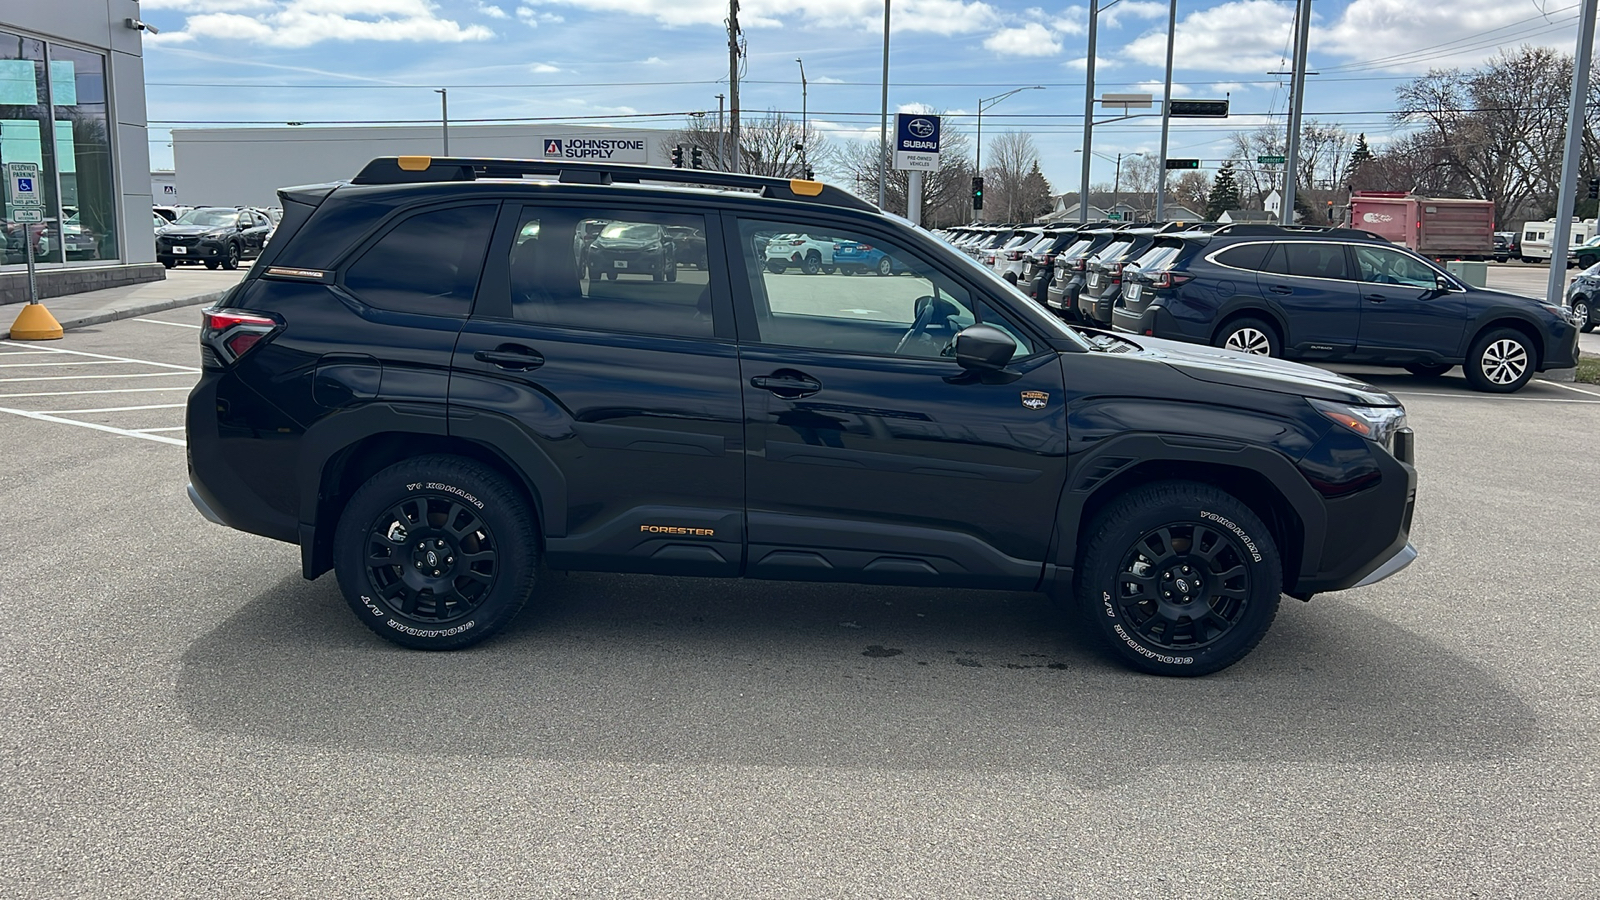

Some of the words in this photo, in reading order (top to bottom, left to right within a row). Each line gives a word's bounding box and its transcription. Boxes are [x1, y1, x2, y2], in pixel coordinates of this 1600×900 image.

[565, 139, 644, 150] JOHNSTONE
[565, 148, 614, 158] SUPPLY
[903, 140, 937, 149] SUBARU
[640, 525, 714, 536] FORESTER
[1200, 510, 1262, 563] YOKOHAMA
[360, 595, 384, 617] A/T
[1103, 591, 1115, 618] A/T
[387, 620, 475, 638] GEOLANDAR
[1113, 623, 1194, 665] GEOLANDAR
